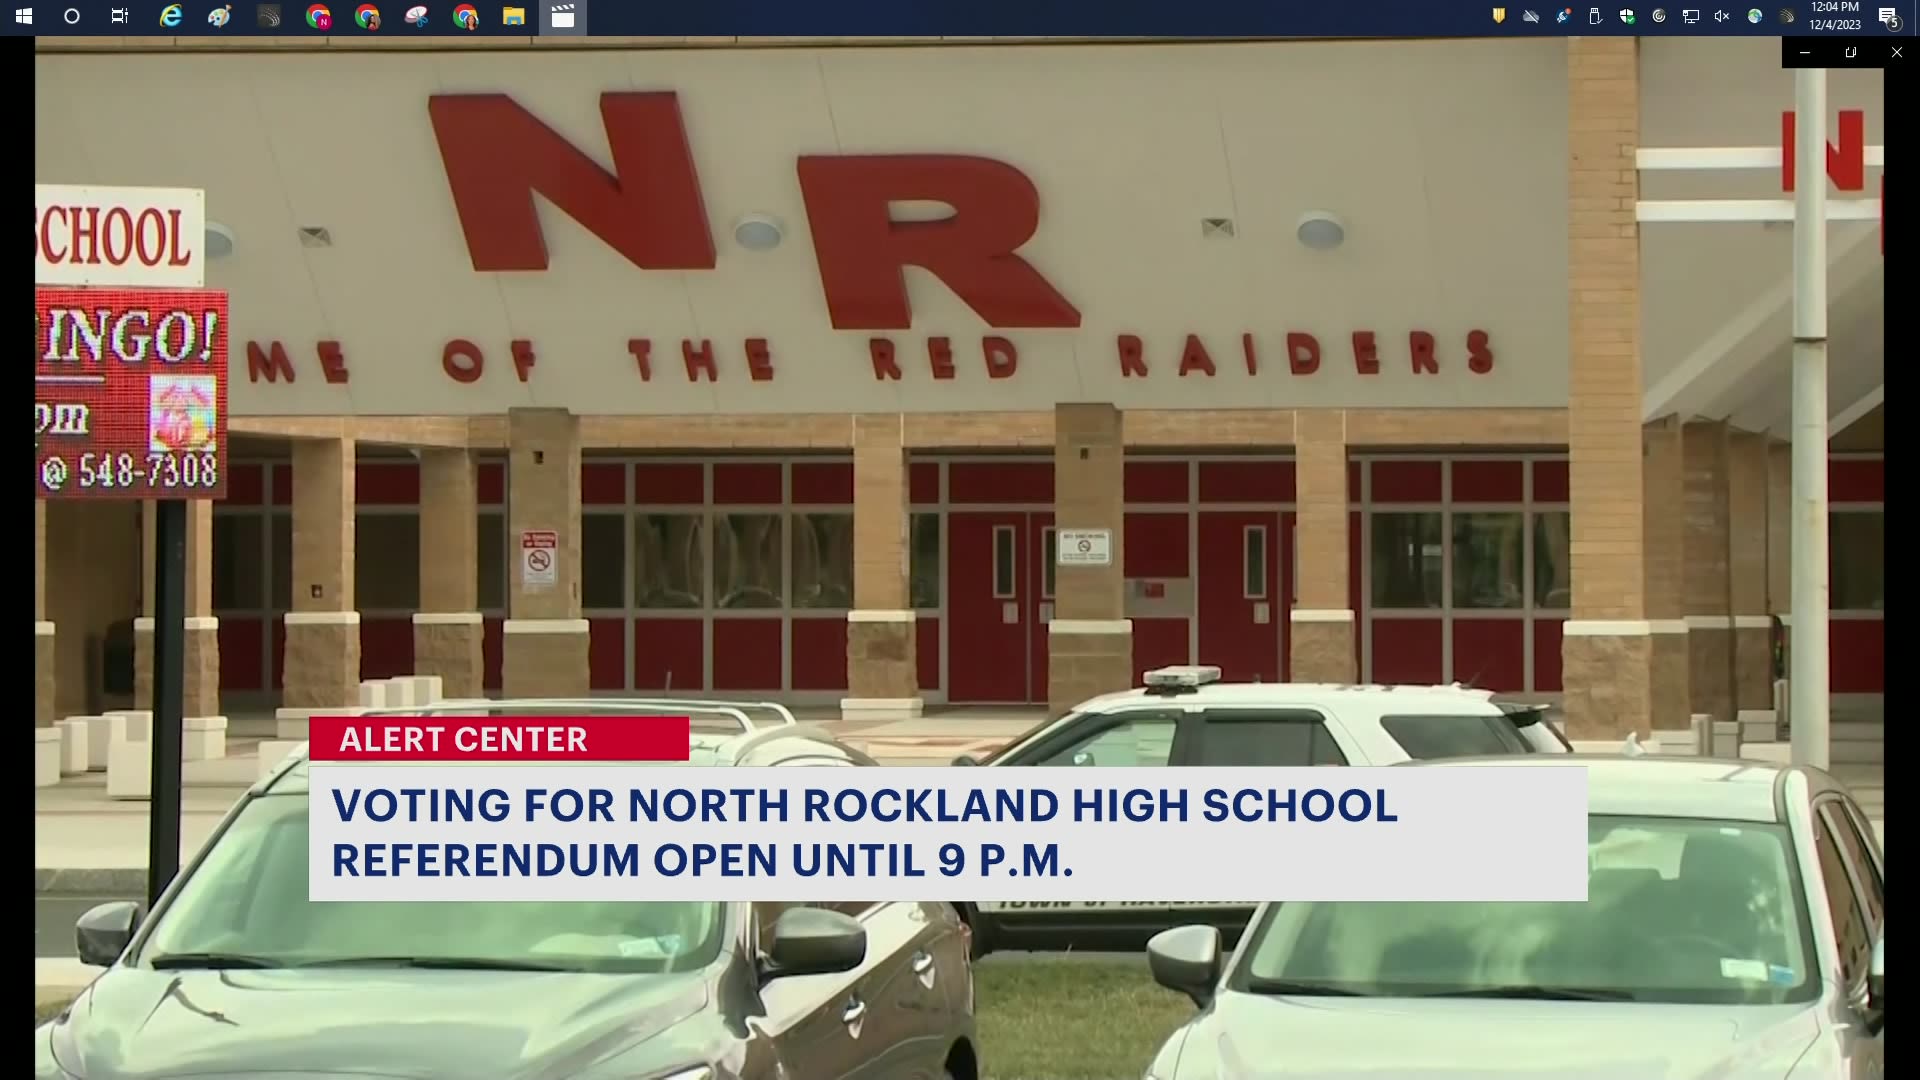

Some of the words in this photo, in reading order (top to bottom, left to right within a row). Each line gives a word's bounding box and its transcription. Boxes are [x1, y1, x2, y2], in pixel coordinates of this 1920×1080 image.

[36, 205, 192, 268] CHOOL
[429, 91, 716, 272] N
[797, 153, 1083, 330] R
[37, 309, 218, 363] INGO!
[442, 339, 535, 384] OF
[628, 338, 774, 383] THE
[869, 336, 1018, 381] RED
[1118, 330, 1495, 378] RAIDERS
[79, 452, 217, 488] 548-7308
